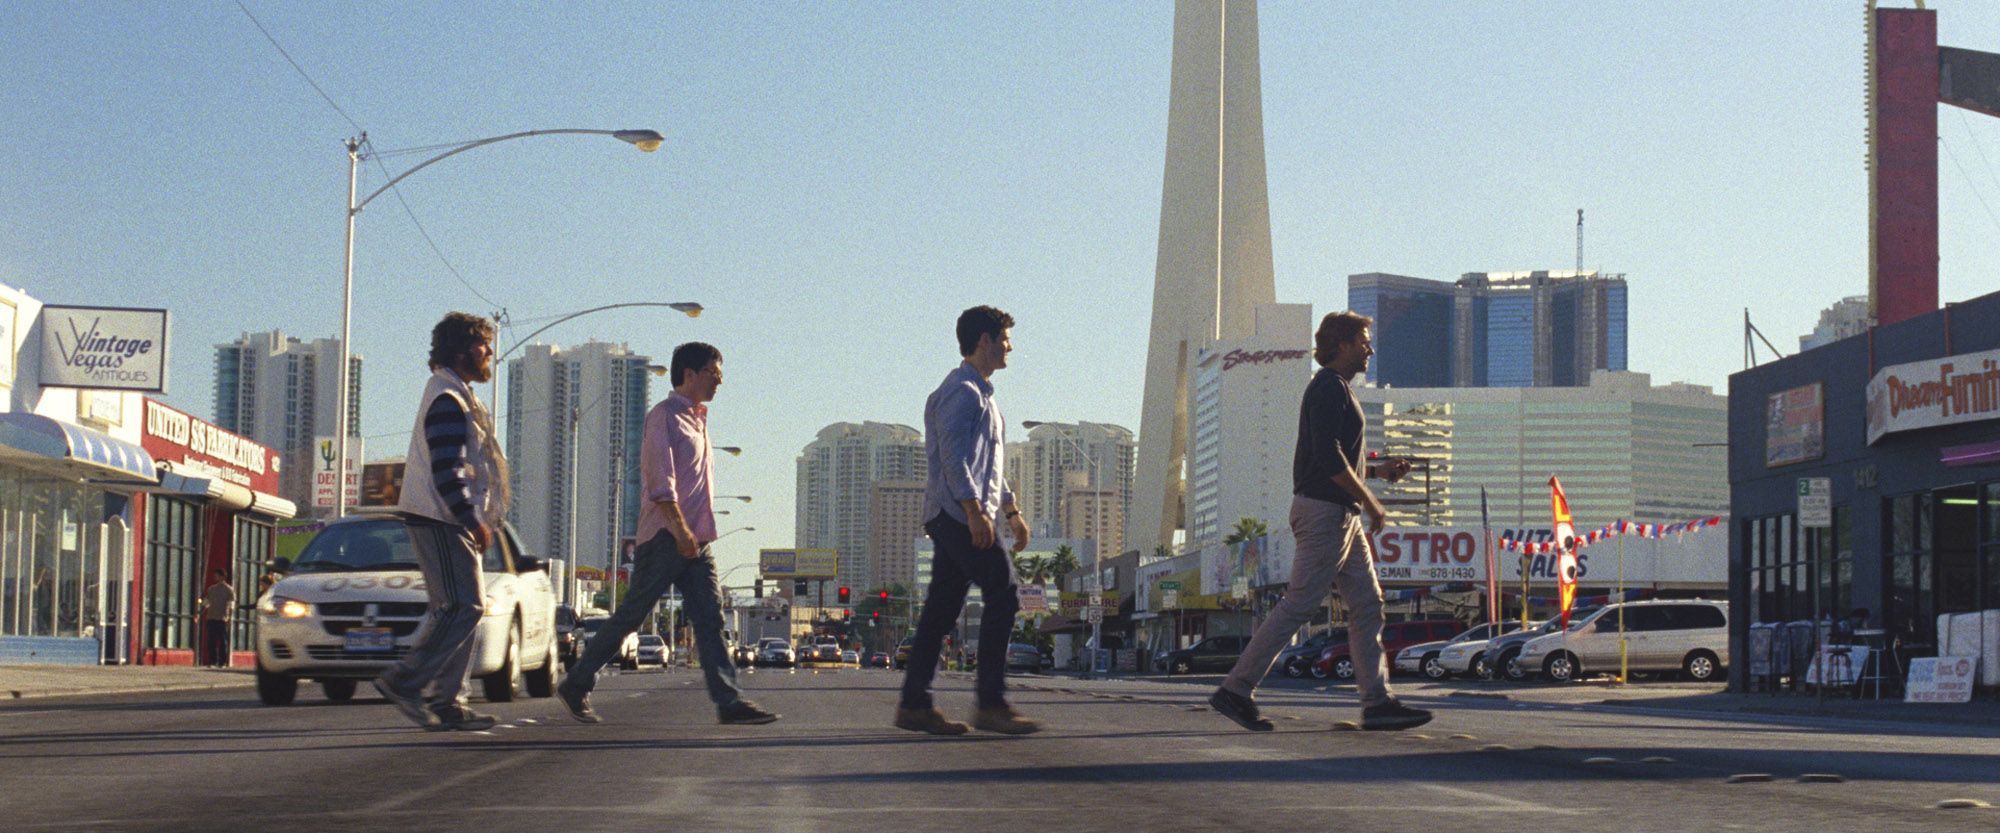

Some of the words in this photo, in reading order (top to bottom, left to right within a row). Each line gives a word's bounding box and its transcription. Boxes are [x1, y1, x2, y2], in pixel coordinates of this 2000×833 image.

[68, 316, 152, 358] Vintage
[55, 331, 124, 374] Vegas
[92, 369, 149, 382] ANTIQUES
[147, 400, 190, 446] UNITED
[206, 424, 266, 476] FABRICATORS
[1799, 480, 1807, 493] 2
[1430, 568, 1475, 579] 878-1430
[1515, 555, 1588, 579] SALS
